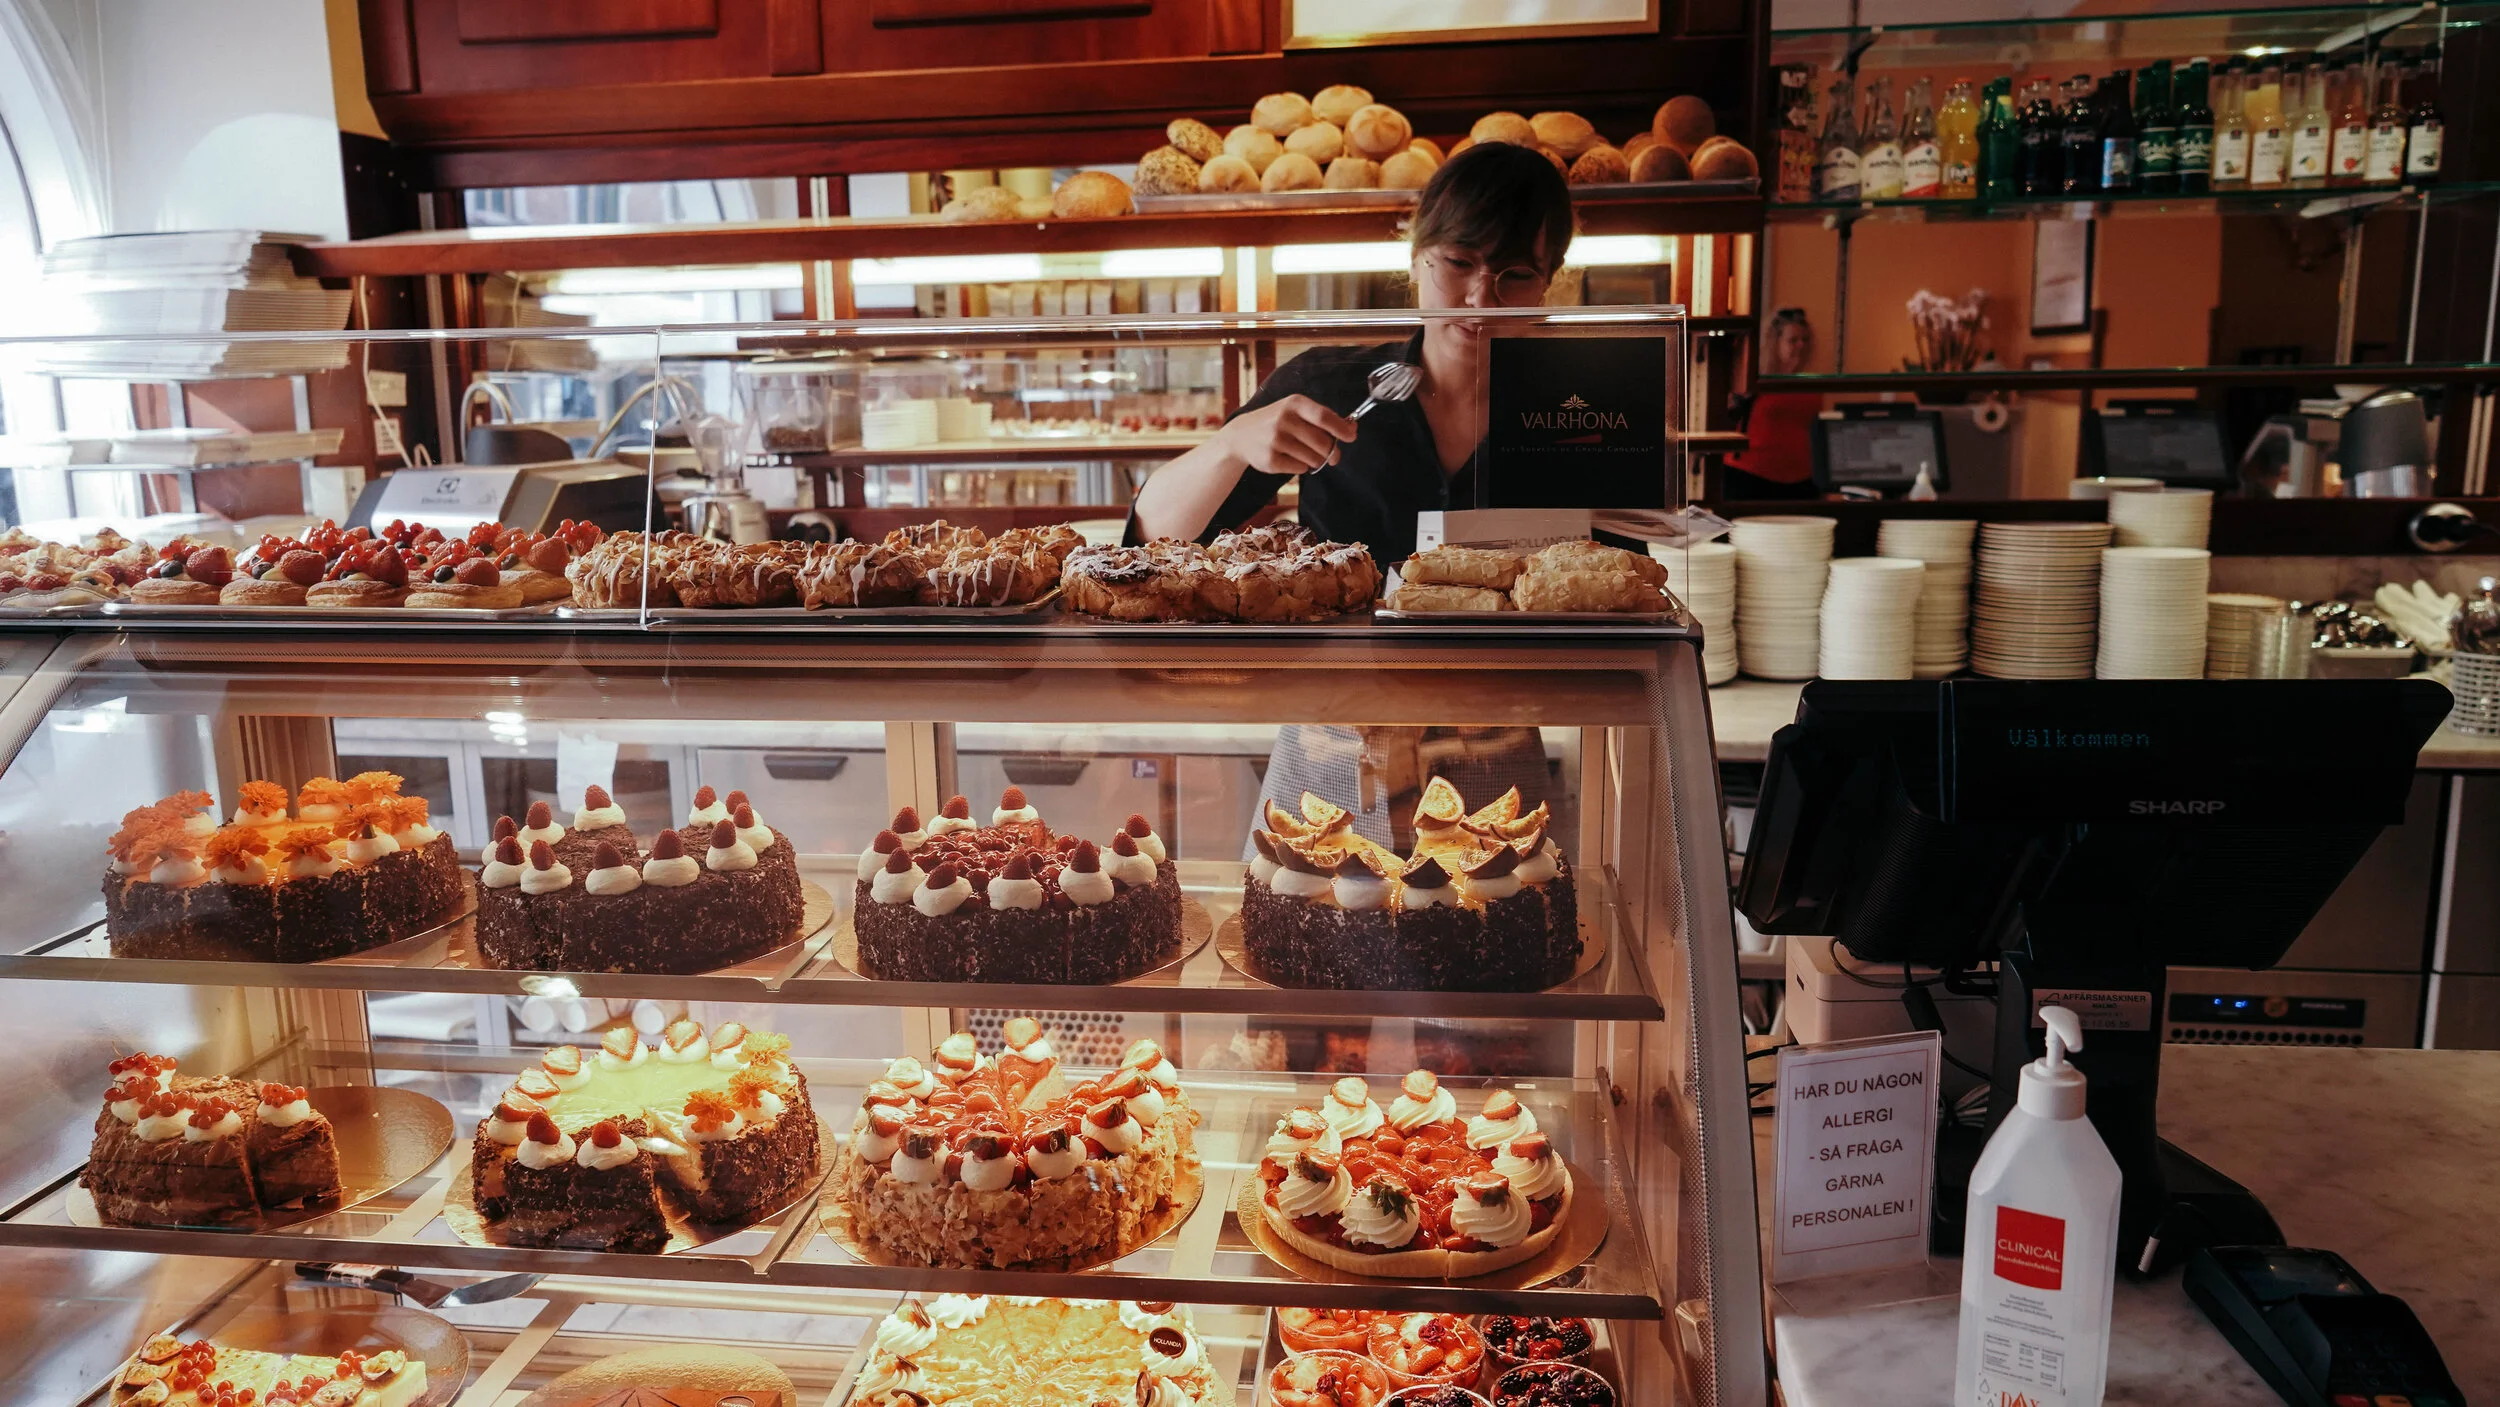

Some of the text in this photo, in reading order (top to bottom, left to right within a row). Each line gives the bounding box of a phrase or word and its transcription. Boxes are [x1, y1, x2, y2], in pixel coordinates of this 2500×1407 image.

[1520, 411, 1629, 430] VALRHONA
[2007, 728, 2152, 748] Välkommen
[2128, 799, 2226, 815] SHARP
[2062, 992, 2147, 1003] AFFÄRSMASKINER
[1794, 1071, 1923, 1101] HAR DU NÅGON
[1822, 1107, 1893, 1130] ALLERGI
[1819, 1145, 1842, 1162] SÅ
[1847, 1138, 1904, 1159] FRÅGA
[1825, 1172, 1884, 1192] GÄRNA
[1792, 1200, 1905, 1229] PERSONALEN
[1997, 1238, 2061, 1263] CLINICAL
[1153, 1337, 1182, 1348] HOLLANDIA
